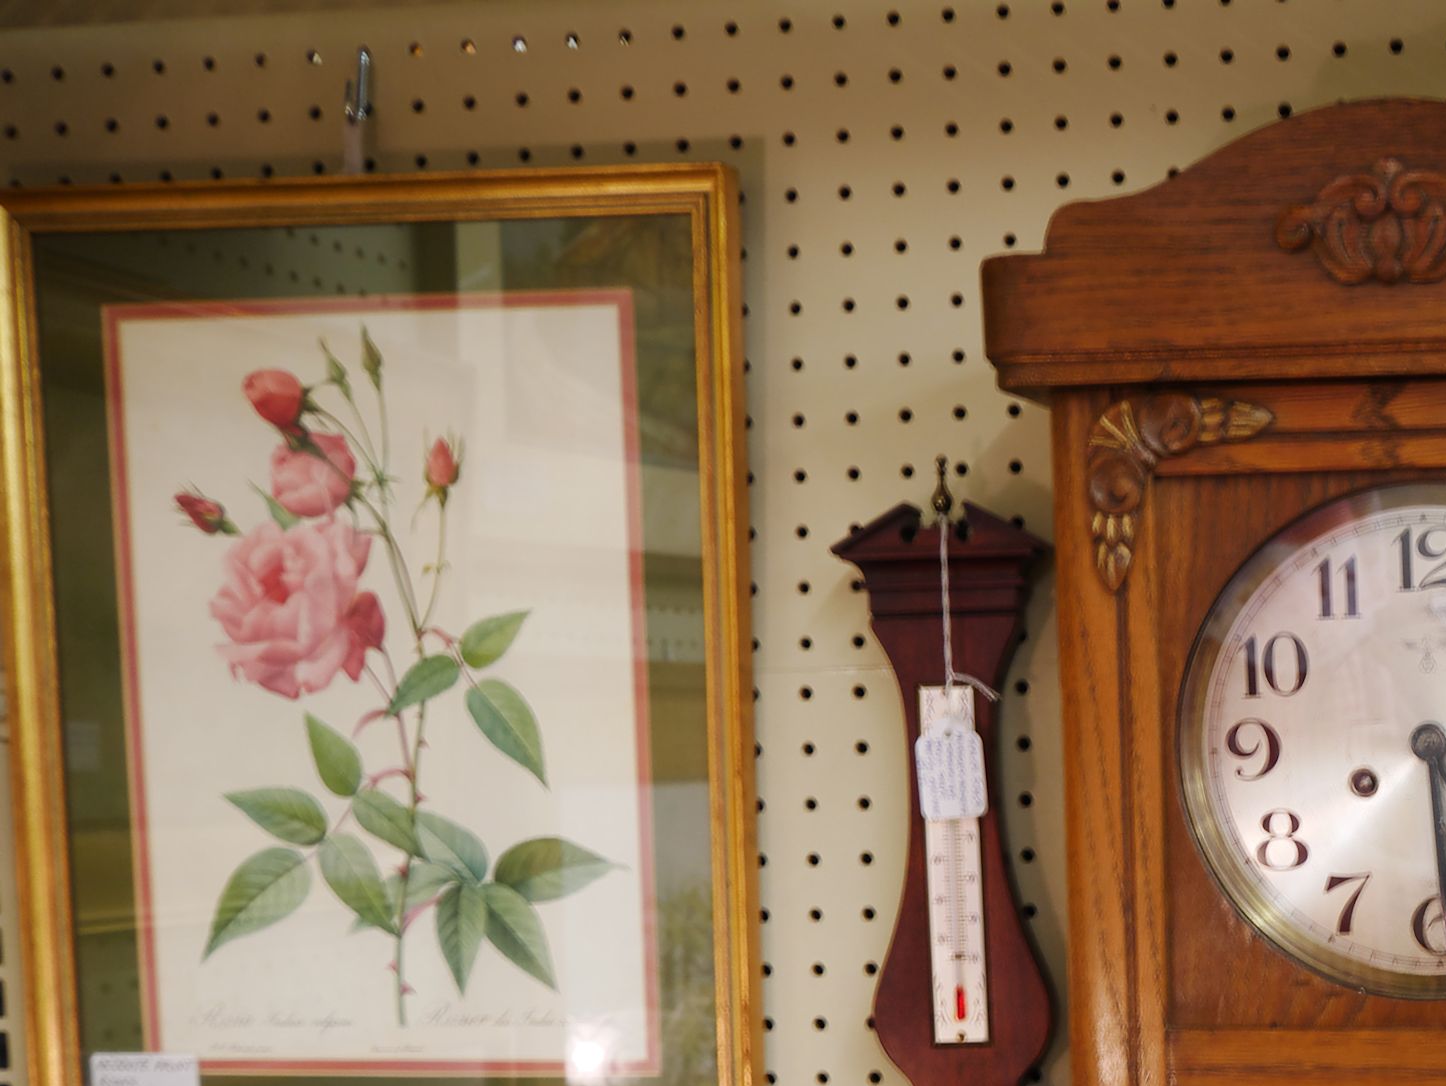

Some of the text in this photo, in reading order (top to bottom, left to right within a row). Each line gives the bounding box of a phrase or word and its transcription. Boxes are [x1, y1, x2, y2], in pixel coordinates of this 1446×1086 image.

[1313, 554, 1360, 620] 11
[1238, 631, 1310, 699] 10
[1226, 716, 1282, 781] 9
[1256, 808, 1310, 871] 8
[1324, 871, 1371, 936] 7
